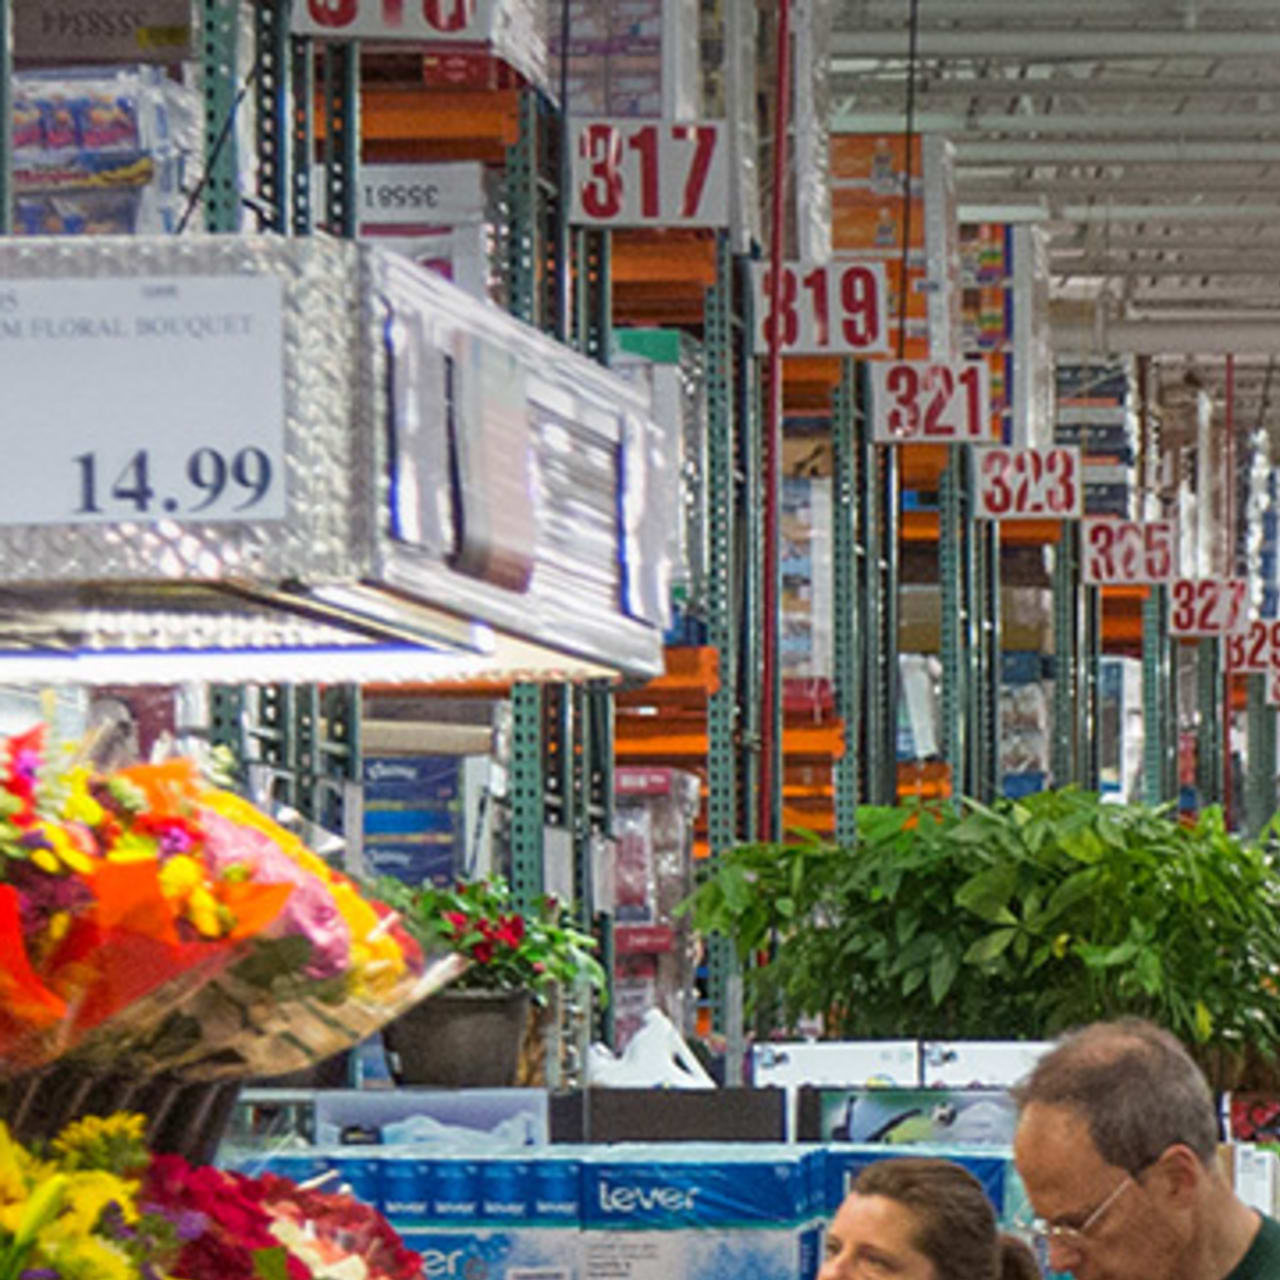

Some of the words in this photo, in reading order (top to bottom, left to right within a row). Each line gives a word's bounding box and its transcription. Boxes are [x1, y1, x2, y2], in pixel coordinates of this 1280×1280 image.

[578, 124, 718, 220] 317
[135, 313, 253, 338] BOUQUET
[762, 265, 880, 348] 319
[886, 365, 982, 437] 321
[71, 446, 273, 514] 14.99
[981, 450, 1075, 514] 323
[1089, 523, 1171, 580] 325
[1173, 579, 1245, 631] 327
